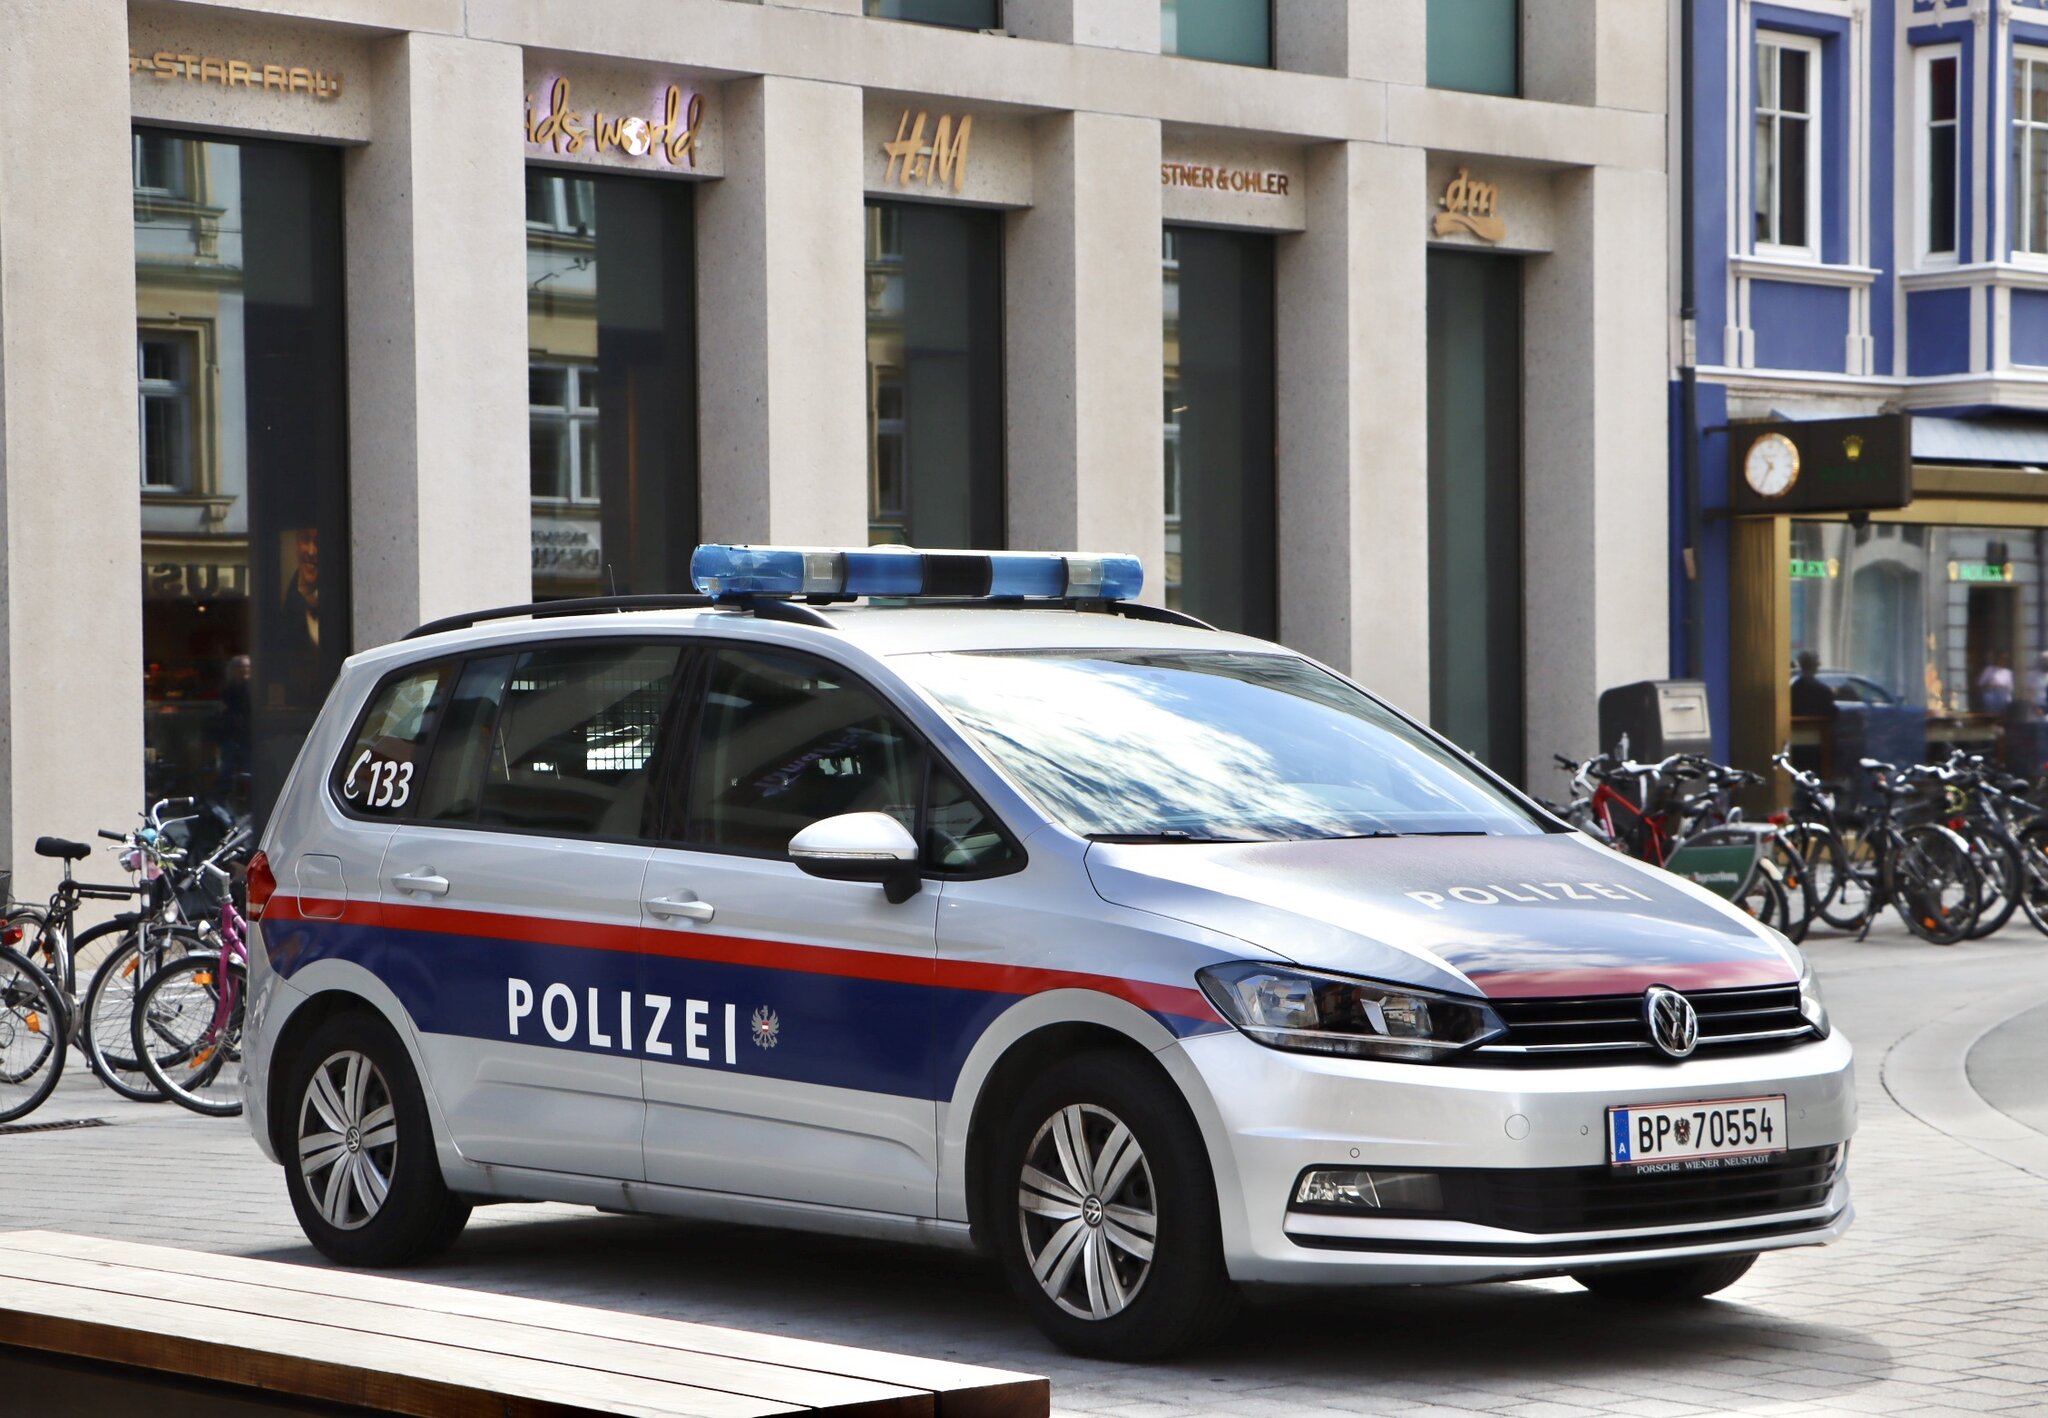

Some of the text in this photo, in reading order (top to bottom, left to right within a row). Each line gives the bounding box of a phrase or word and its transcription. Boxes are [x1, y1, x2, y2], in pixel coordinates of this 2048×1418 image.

[263, 63, 344, 98] RAW
[524, 76, 705, 167] ids world
[883, 109, 972, 192] H&M
[1216, 168, 1230, 191] &
[1230, 170, 1289, 196] OHLER
[1446, 167, 1498, 214] dm
[366, 760, 414, 808] 133
[1405, 882, 1653, 910] POLIZEI
[508, 977, 737, 1065] POLIZEI
[1618, 1142, 1627, 1154] A
[1638, 1107, 1773, 1153] BP 70554
[1636, 1154, 1770, 1175] PORSCHE WIENER NEUSTADT
